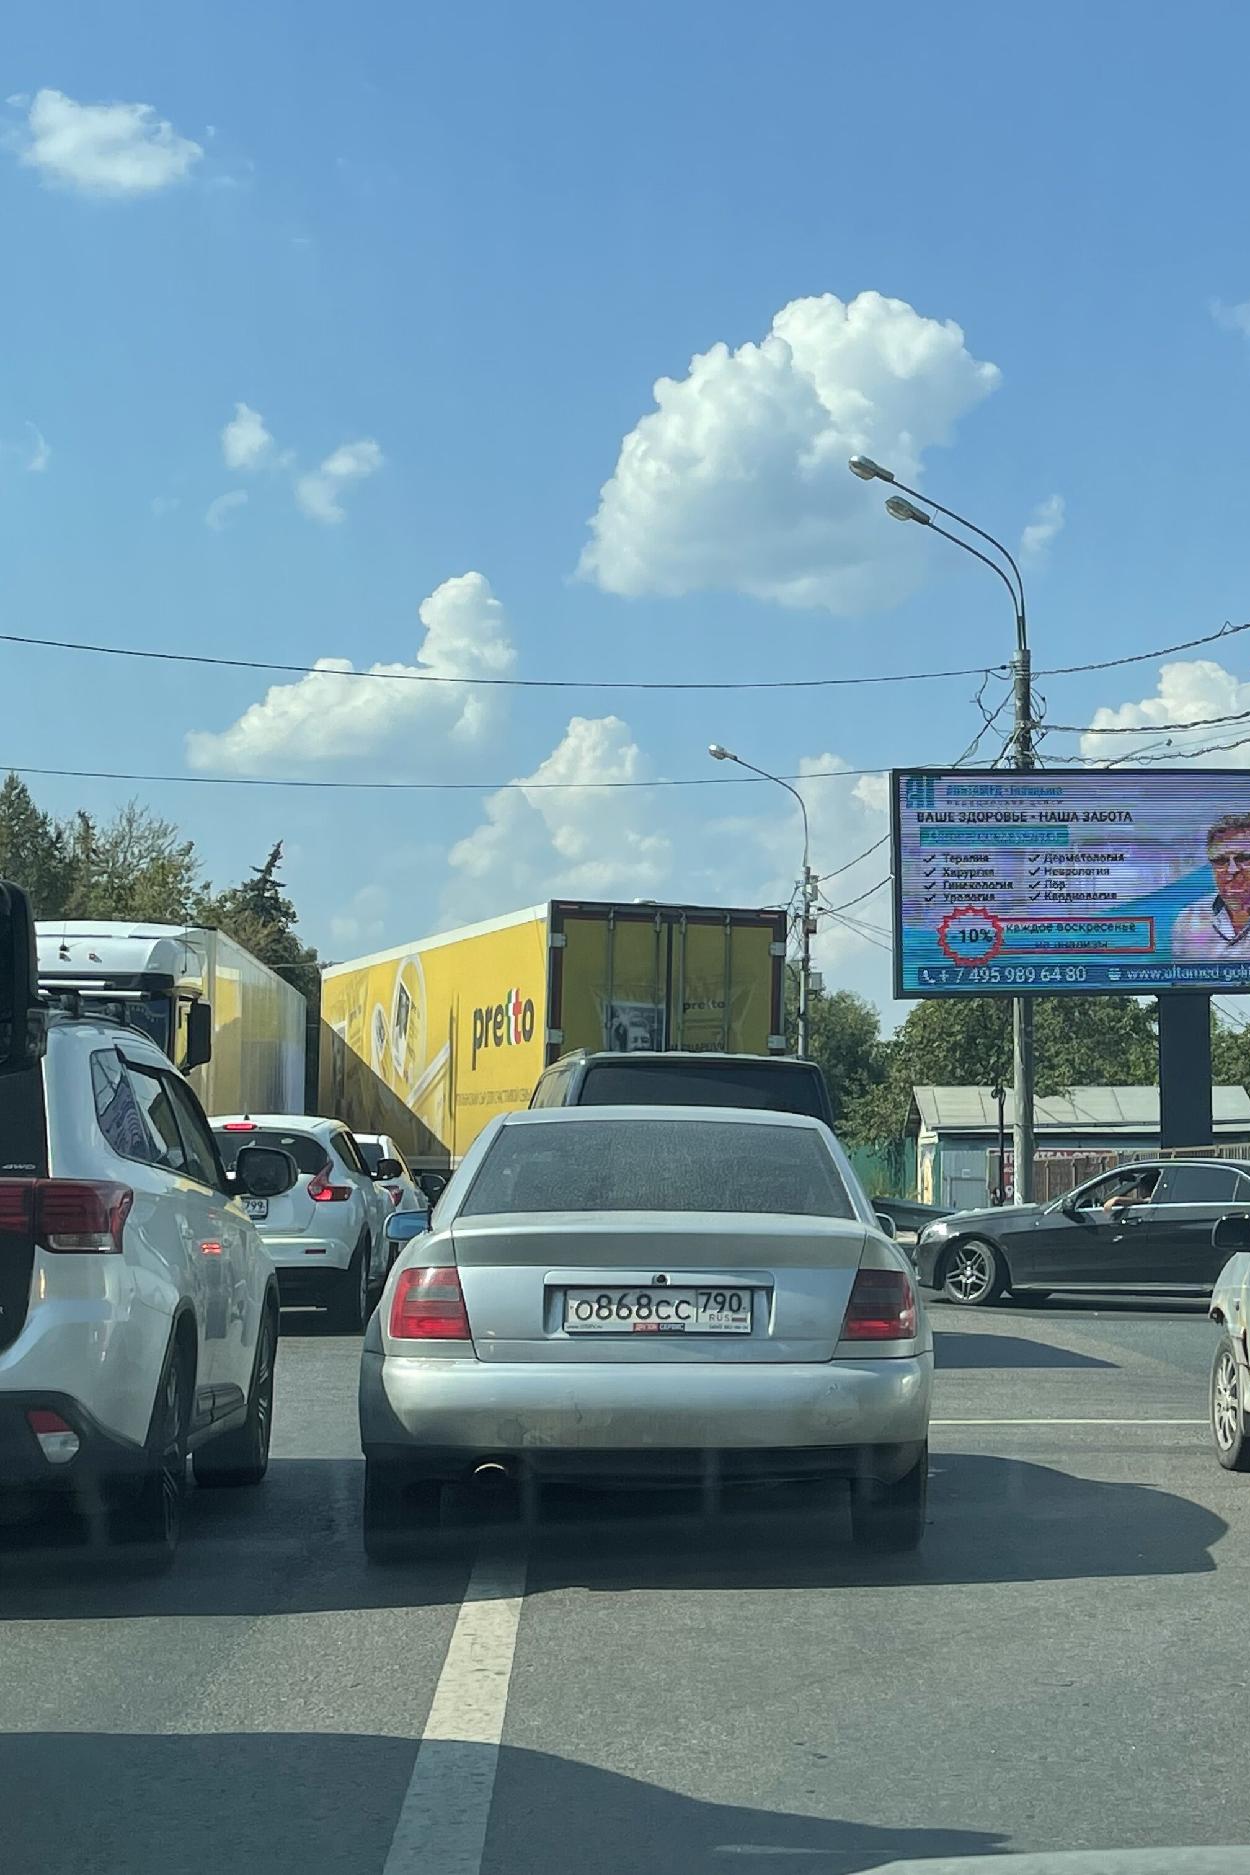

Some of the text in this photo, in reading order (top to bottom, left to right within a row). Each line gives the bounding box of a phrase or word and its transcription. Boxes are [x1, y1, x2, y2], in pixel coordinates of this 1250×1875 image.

[917, 811, 954, 823] ВАШЕ
[958, 811, 1029, 824] ЗДОРОВЬЕ
[1039, 811, 1079, 823] НАША
[1082, 811, 1133, 823] ЗАБОТА
[968, 966, 1001, 983] 495
[1004, 966, 1036, 983] 989
[1039, 966, 1062, 983] 64
[1065, 965, 1087, 983] 80
[574, 1291, 744, 1321] О868СС 790
[708, 1313, 731, 1322] RUS
